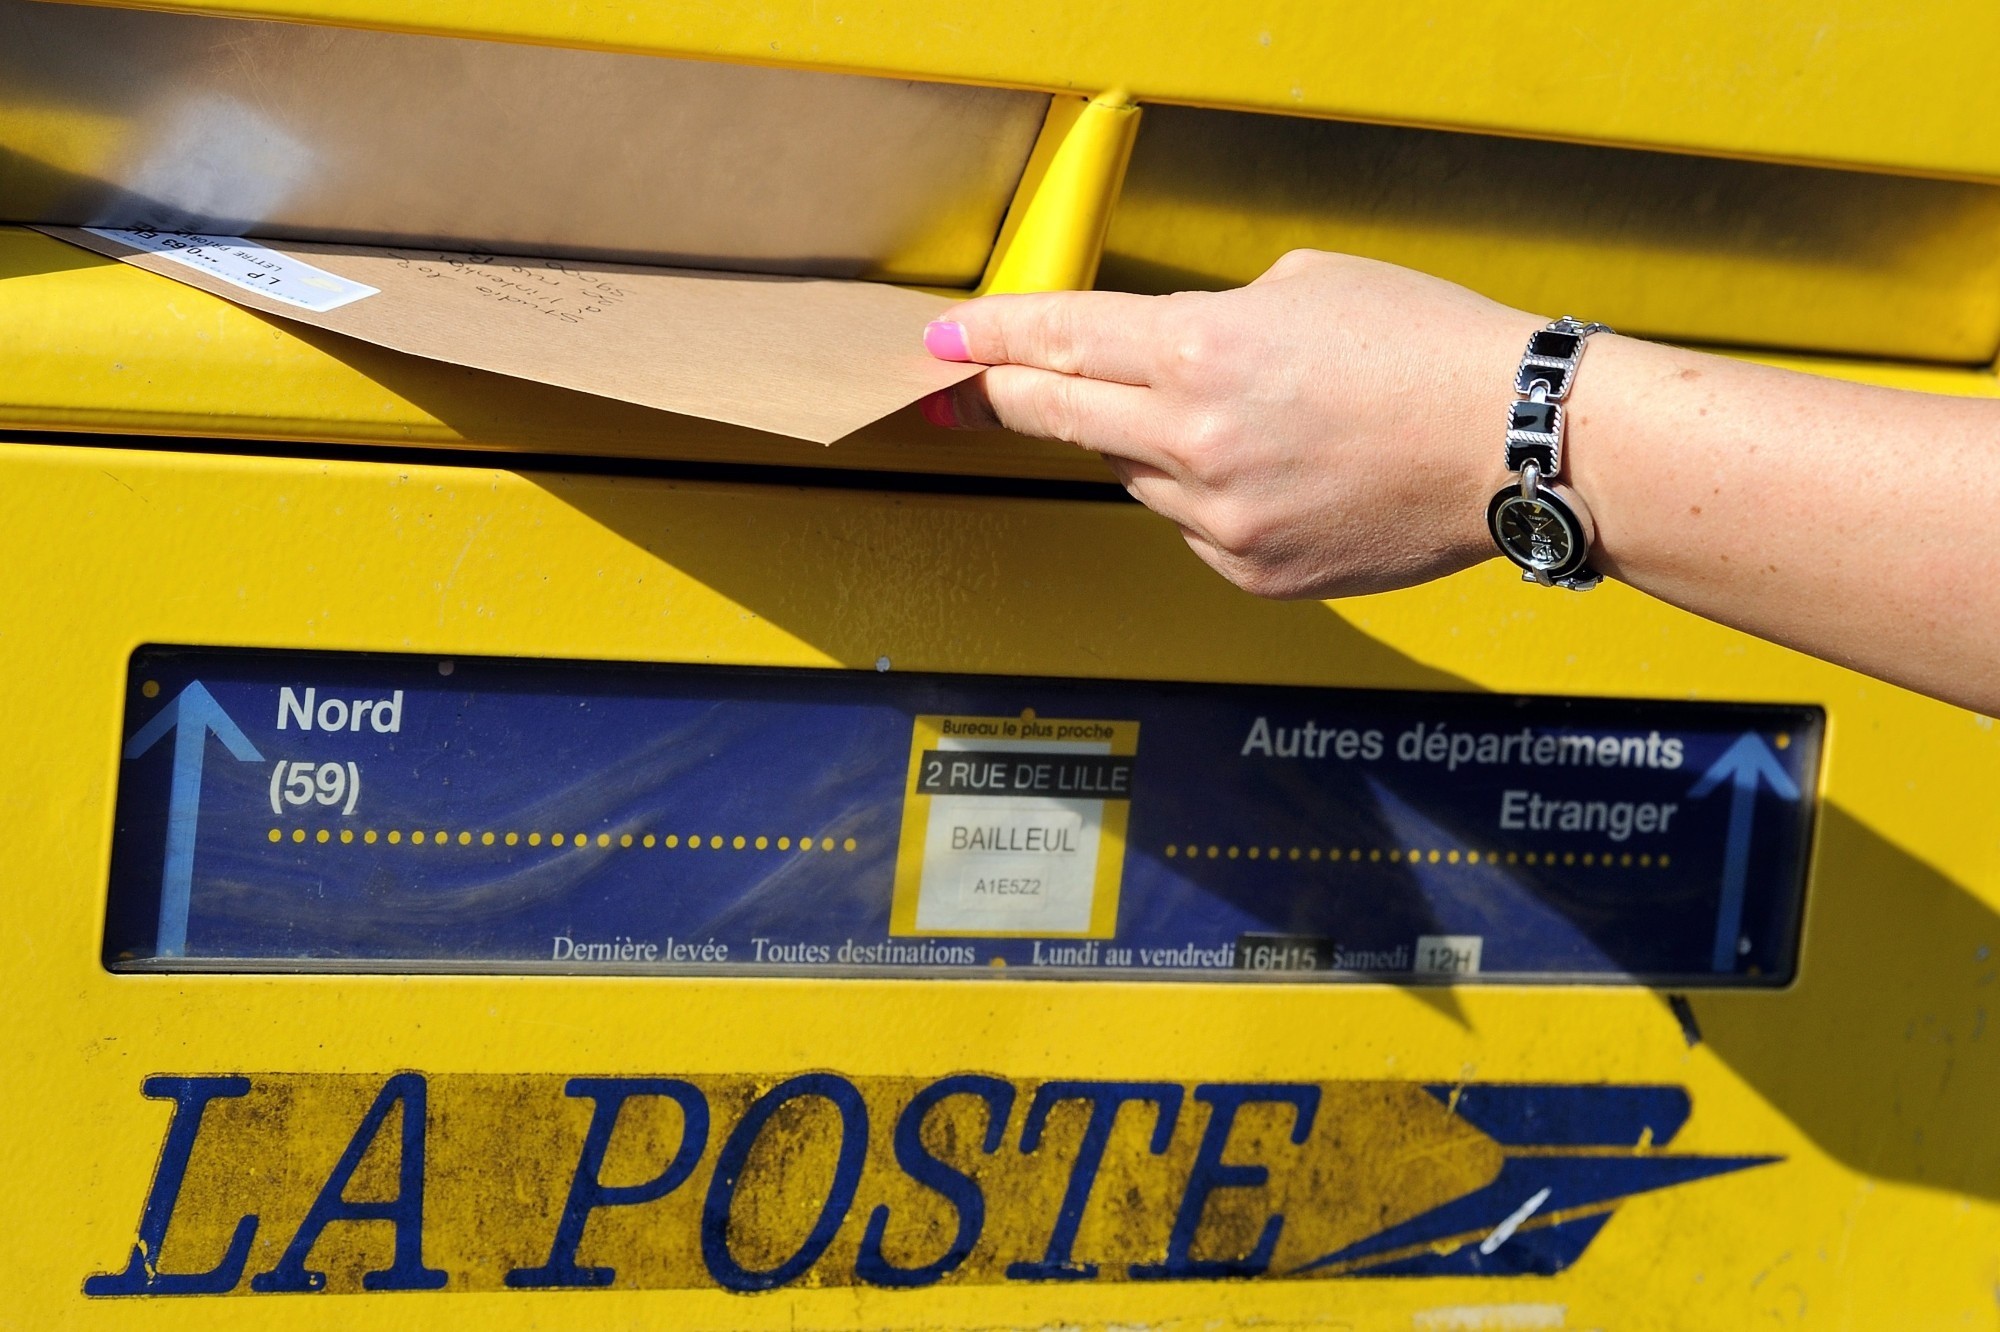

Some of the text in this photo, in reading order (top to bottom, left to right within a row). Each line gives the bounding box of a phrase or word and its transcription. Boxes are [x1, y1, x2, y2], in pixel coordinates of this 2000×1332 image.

[233, 251, 283, 272] LETTRE
[475, 285, 584, 323] Studio
[277, 686, 404, 733] Nord
[942, 719, 1114, 739] Bureau le plus proche
[1241, 716, 1684, 771] Autres départements
[269, 760, 360, 815] (59)
[925, 761, 1129, 791] 2 RUE DE LILLE
[1500, 790, 1677, 841] Etranger
[952, 826, 1075, 852] BAILLEUL
[974, 878, 1041, 895] A1E5Z2
[552, 936, 1473, 973] Dernière levée Toutes destinations Lundi au vendredi 16H15 Samedi 12H
[84, 1071, 1321, 1296] LA POSTE
